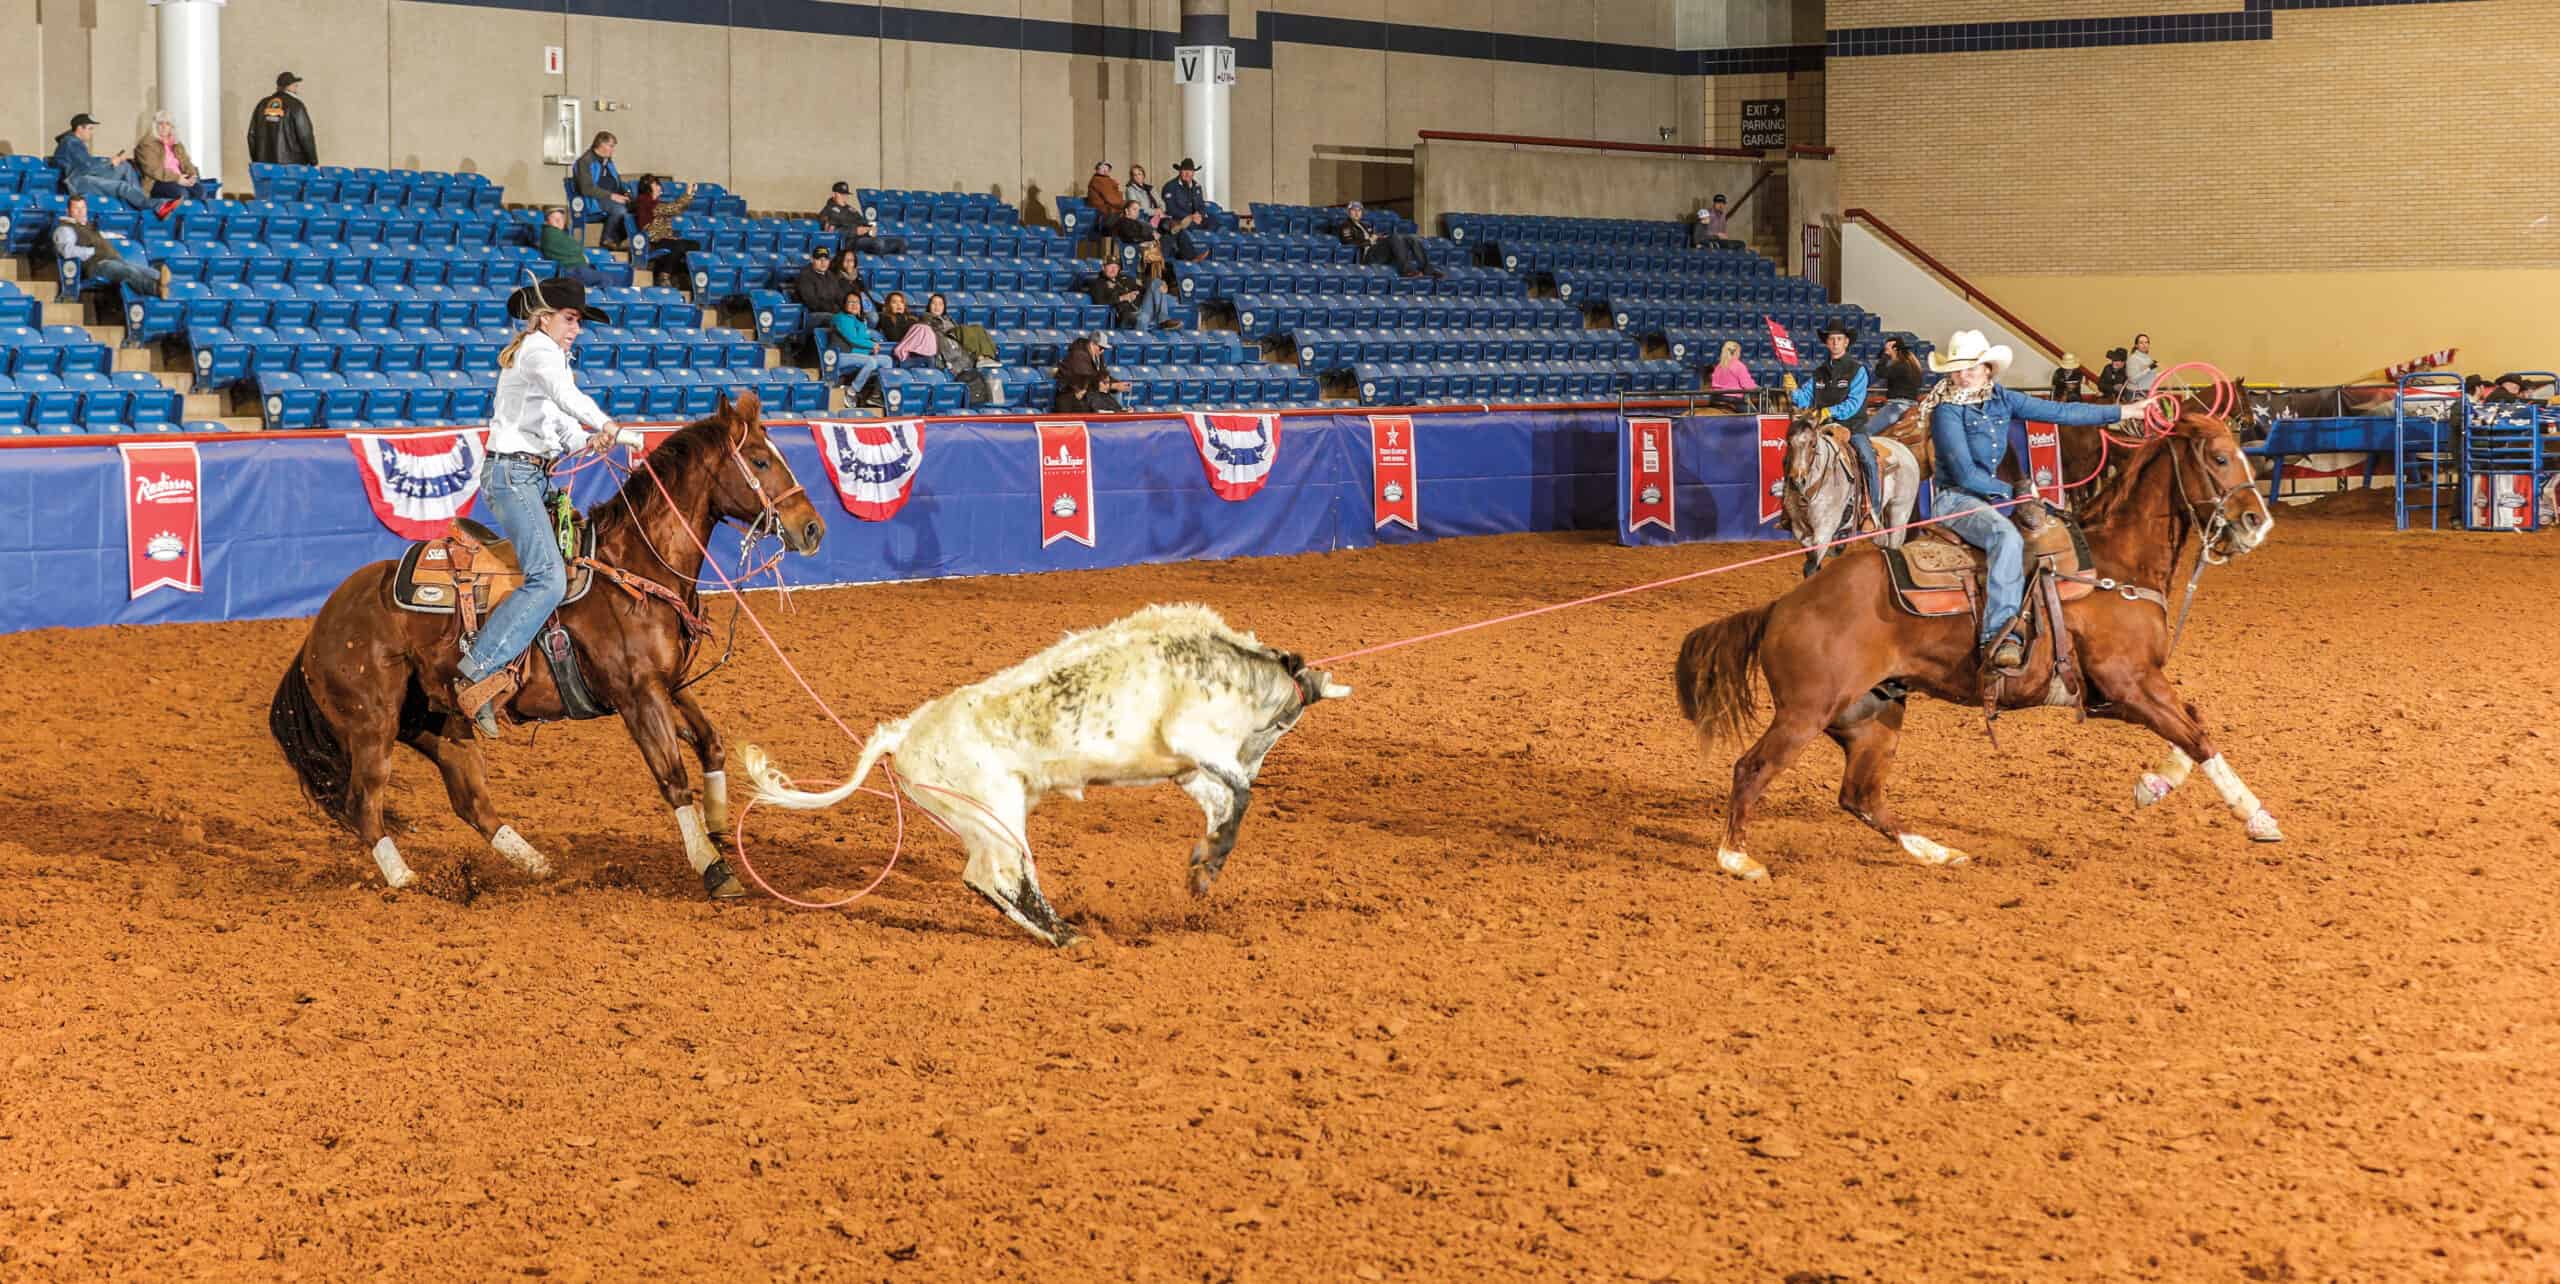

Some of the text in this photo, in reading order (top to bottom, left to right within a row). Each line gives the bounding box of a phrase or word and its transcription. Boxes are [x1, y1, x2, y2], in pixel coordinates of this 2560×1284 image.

[1223, 54, 1229, 70] V
[1181, 56, 1197, 81] V
[1746, 104, 1768, 116] EXIT
[1742, 119, 1785, 131] PARKING
[1743, 134, 1784, 146] GARAGE
